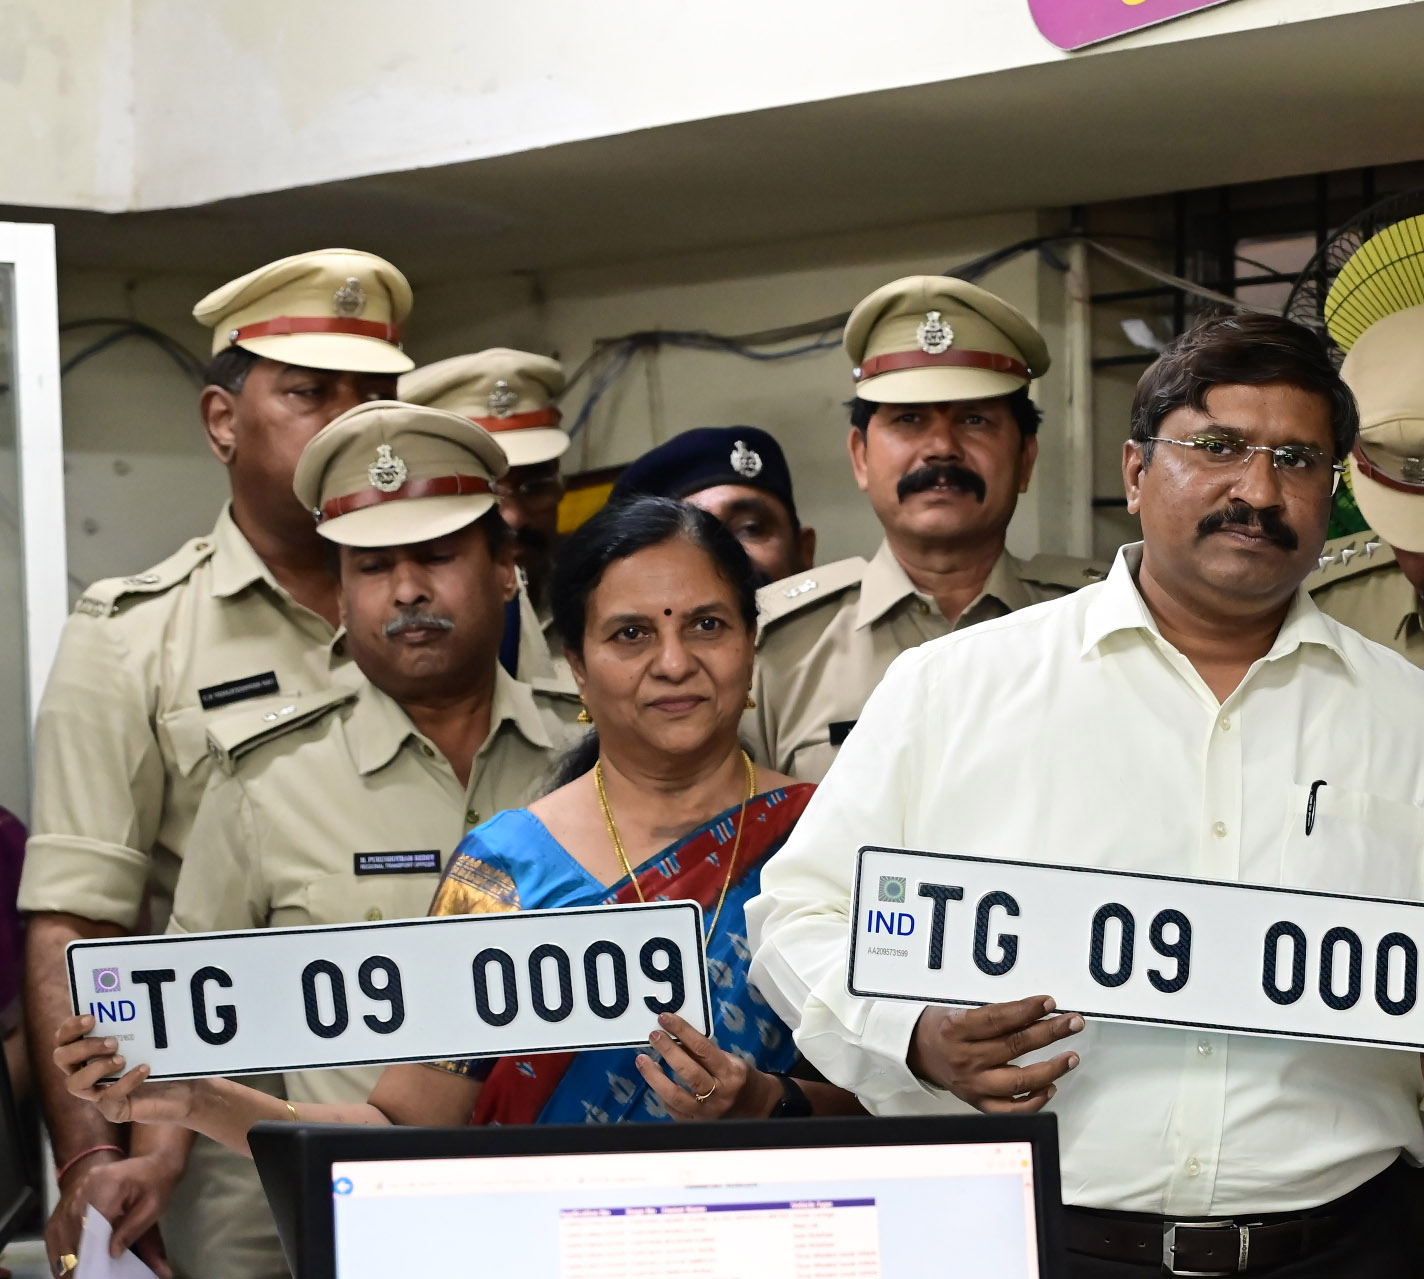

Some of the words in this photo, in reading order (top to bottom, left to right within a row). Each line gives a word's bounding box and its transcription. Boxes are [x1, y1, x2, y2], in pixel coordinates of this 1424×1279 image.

[867, 909, 915, 937] IND
[917, 881, 1022, 977] TG
[1088, 902, 1193, 994] 09
[89, 1000, 136, 1024] IND
[130, 965, 239, 1050] TG
[301, 955, 406, 1039] 09
[471, 936, 686, 1028] 0009
